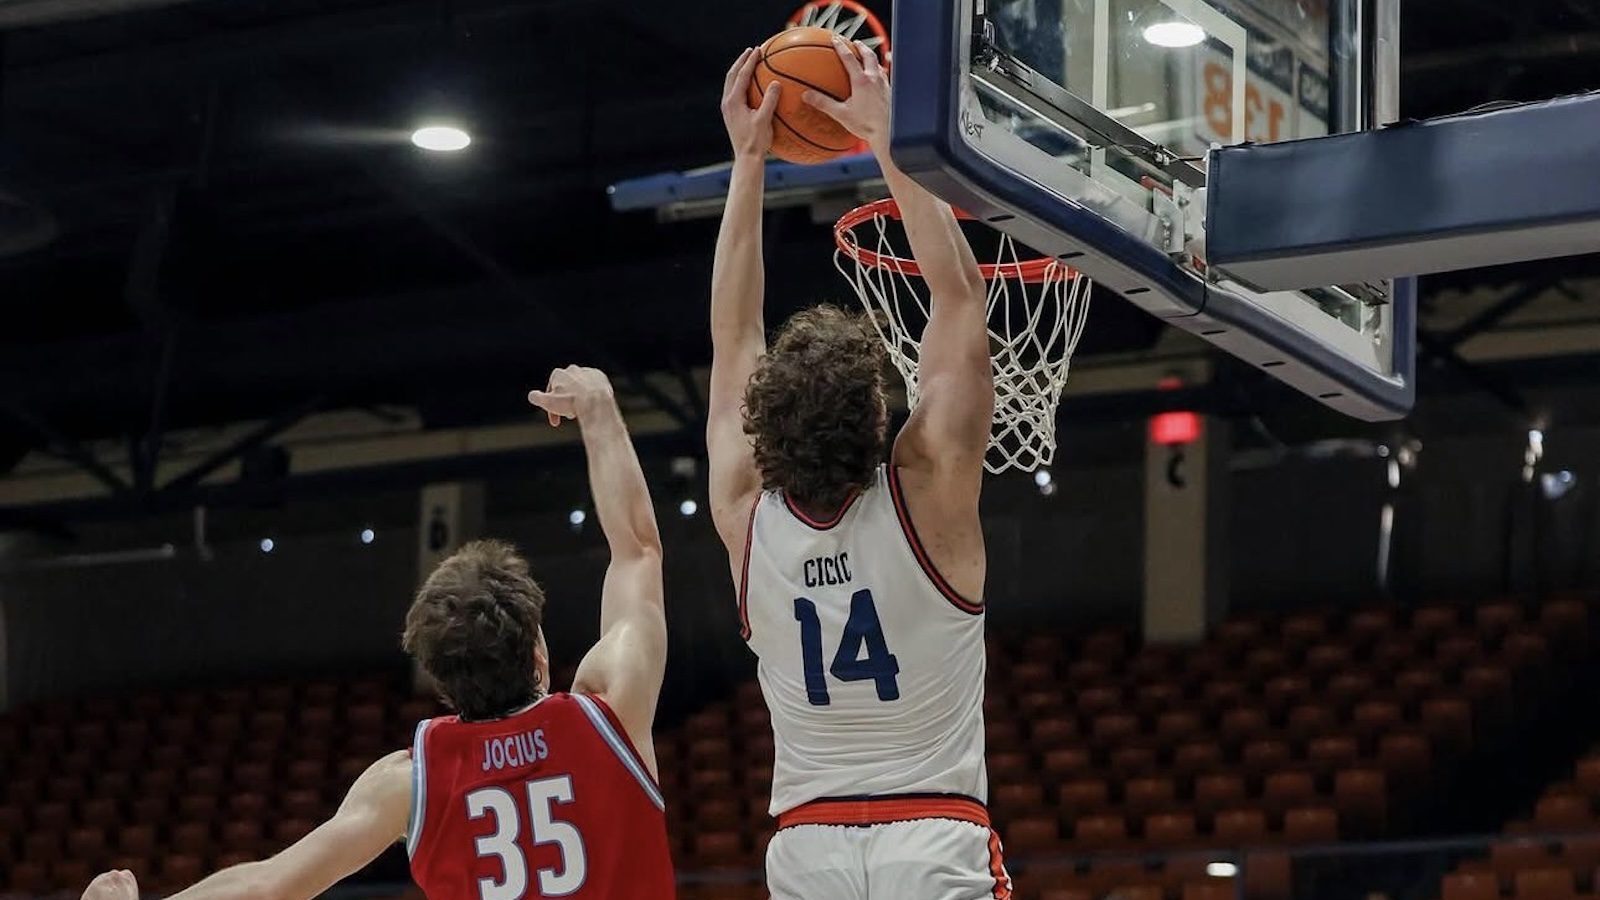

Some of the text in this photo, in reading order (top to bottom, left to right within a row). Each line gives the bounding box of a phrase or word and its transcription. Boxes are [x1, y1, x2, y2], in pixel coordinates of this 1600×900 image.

[1167, 452, 1187, 489] C
[794, 589, 900, 705] 14
[482, 729, 550, 771] JOCIUS
[467, 775, 588, 900] 35
